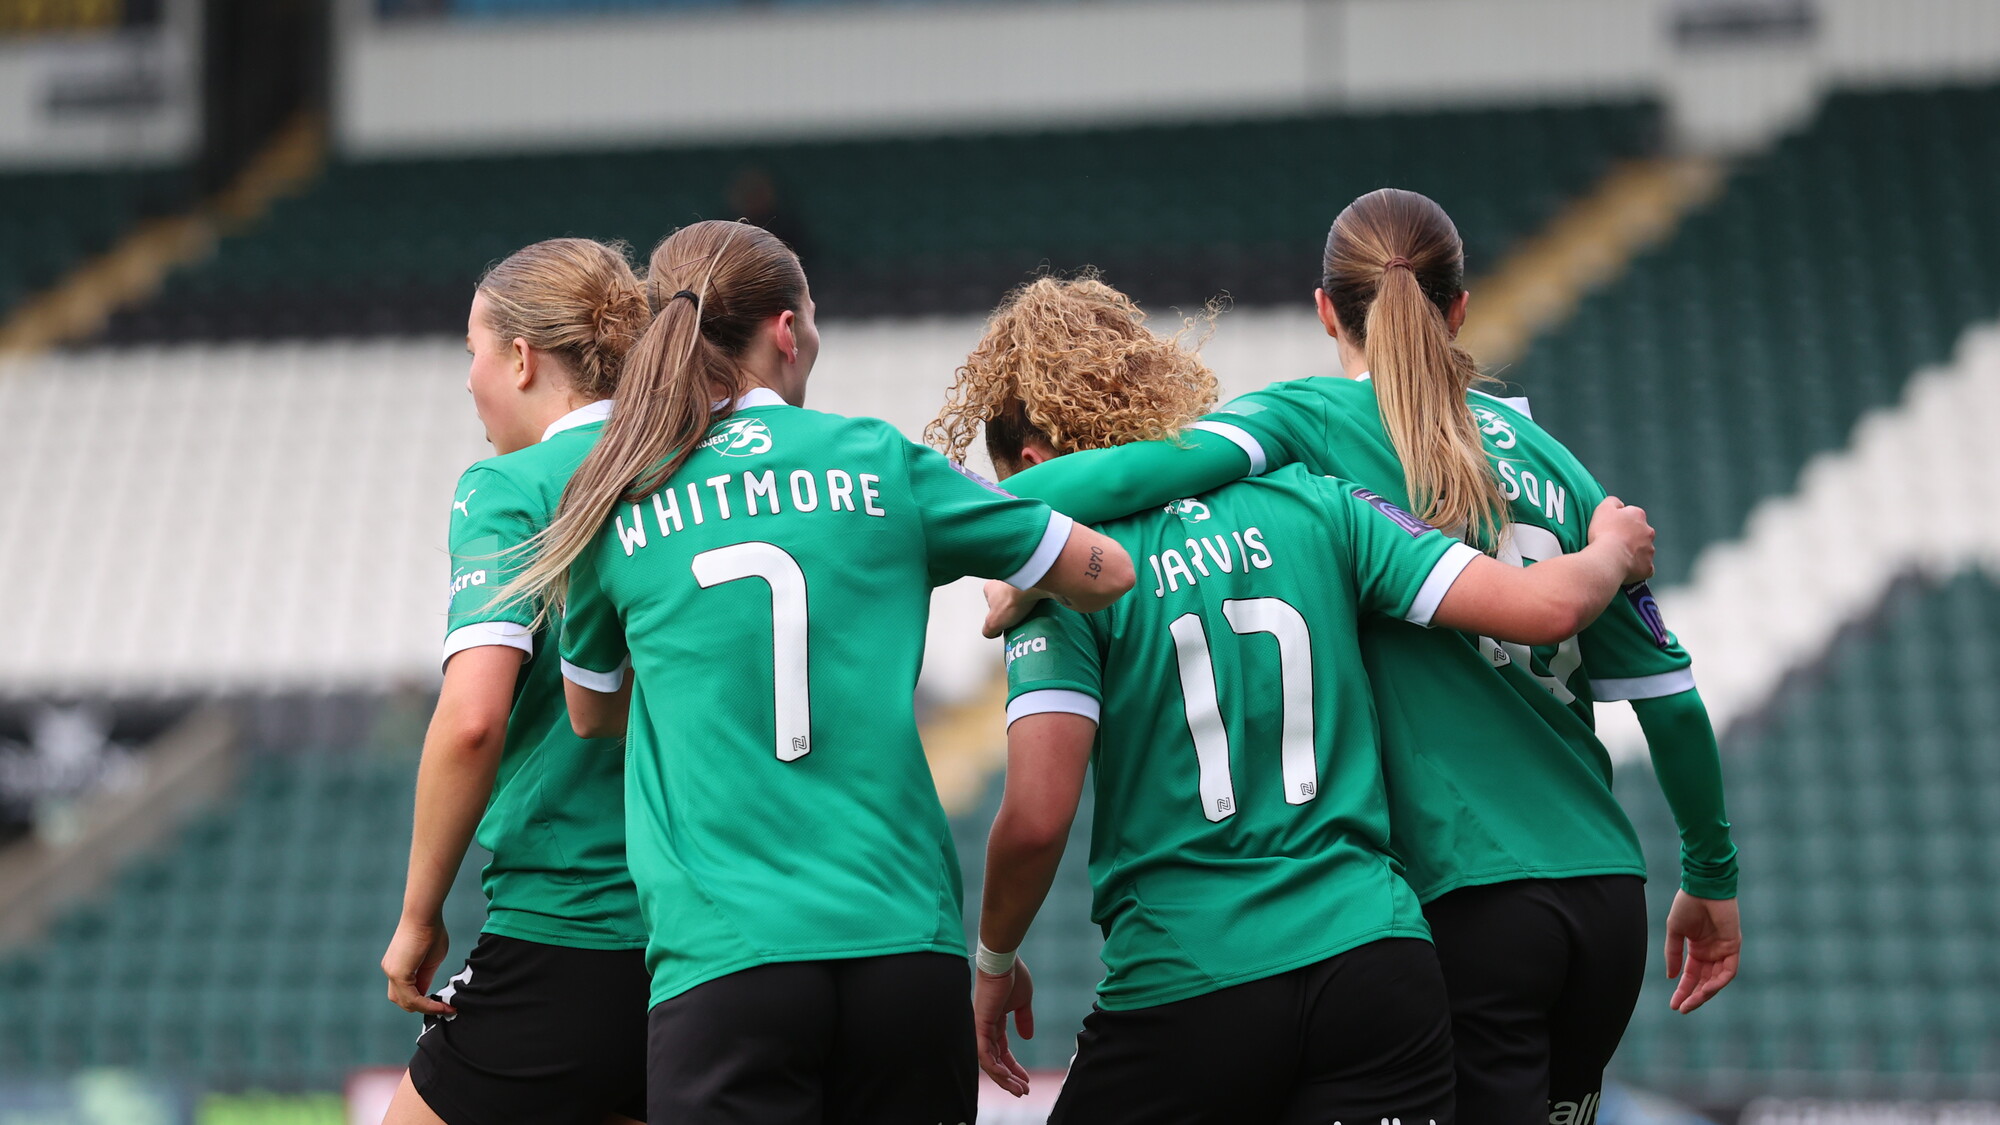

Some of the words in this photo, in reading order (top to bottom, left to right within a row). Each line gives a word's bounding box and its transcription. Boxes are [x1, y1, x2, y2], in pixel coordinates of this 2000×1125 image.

[695, 432, 730, 451] OJECT
[614, 469, 887, 558] WHITMORE
[1498, 459, 1566, 526] SON
[450, 569, 487, 600] xtra
[1084, 545, 1104, 580] 1970
[1148, 526, 1274, 598] JARVIS
[690, 540, 812, 763] 7
[1006, 636, 1047, 665] xtra
[1168, 596, 1319, 824] 17
